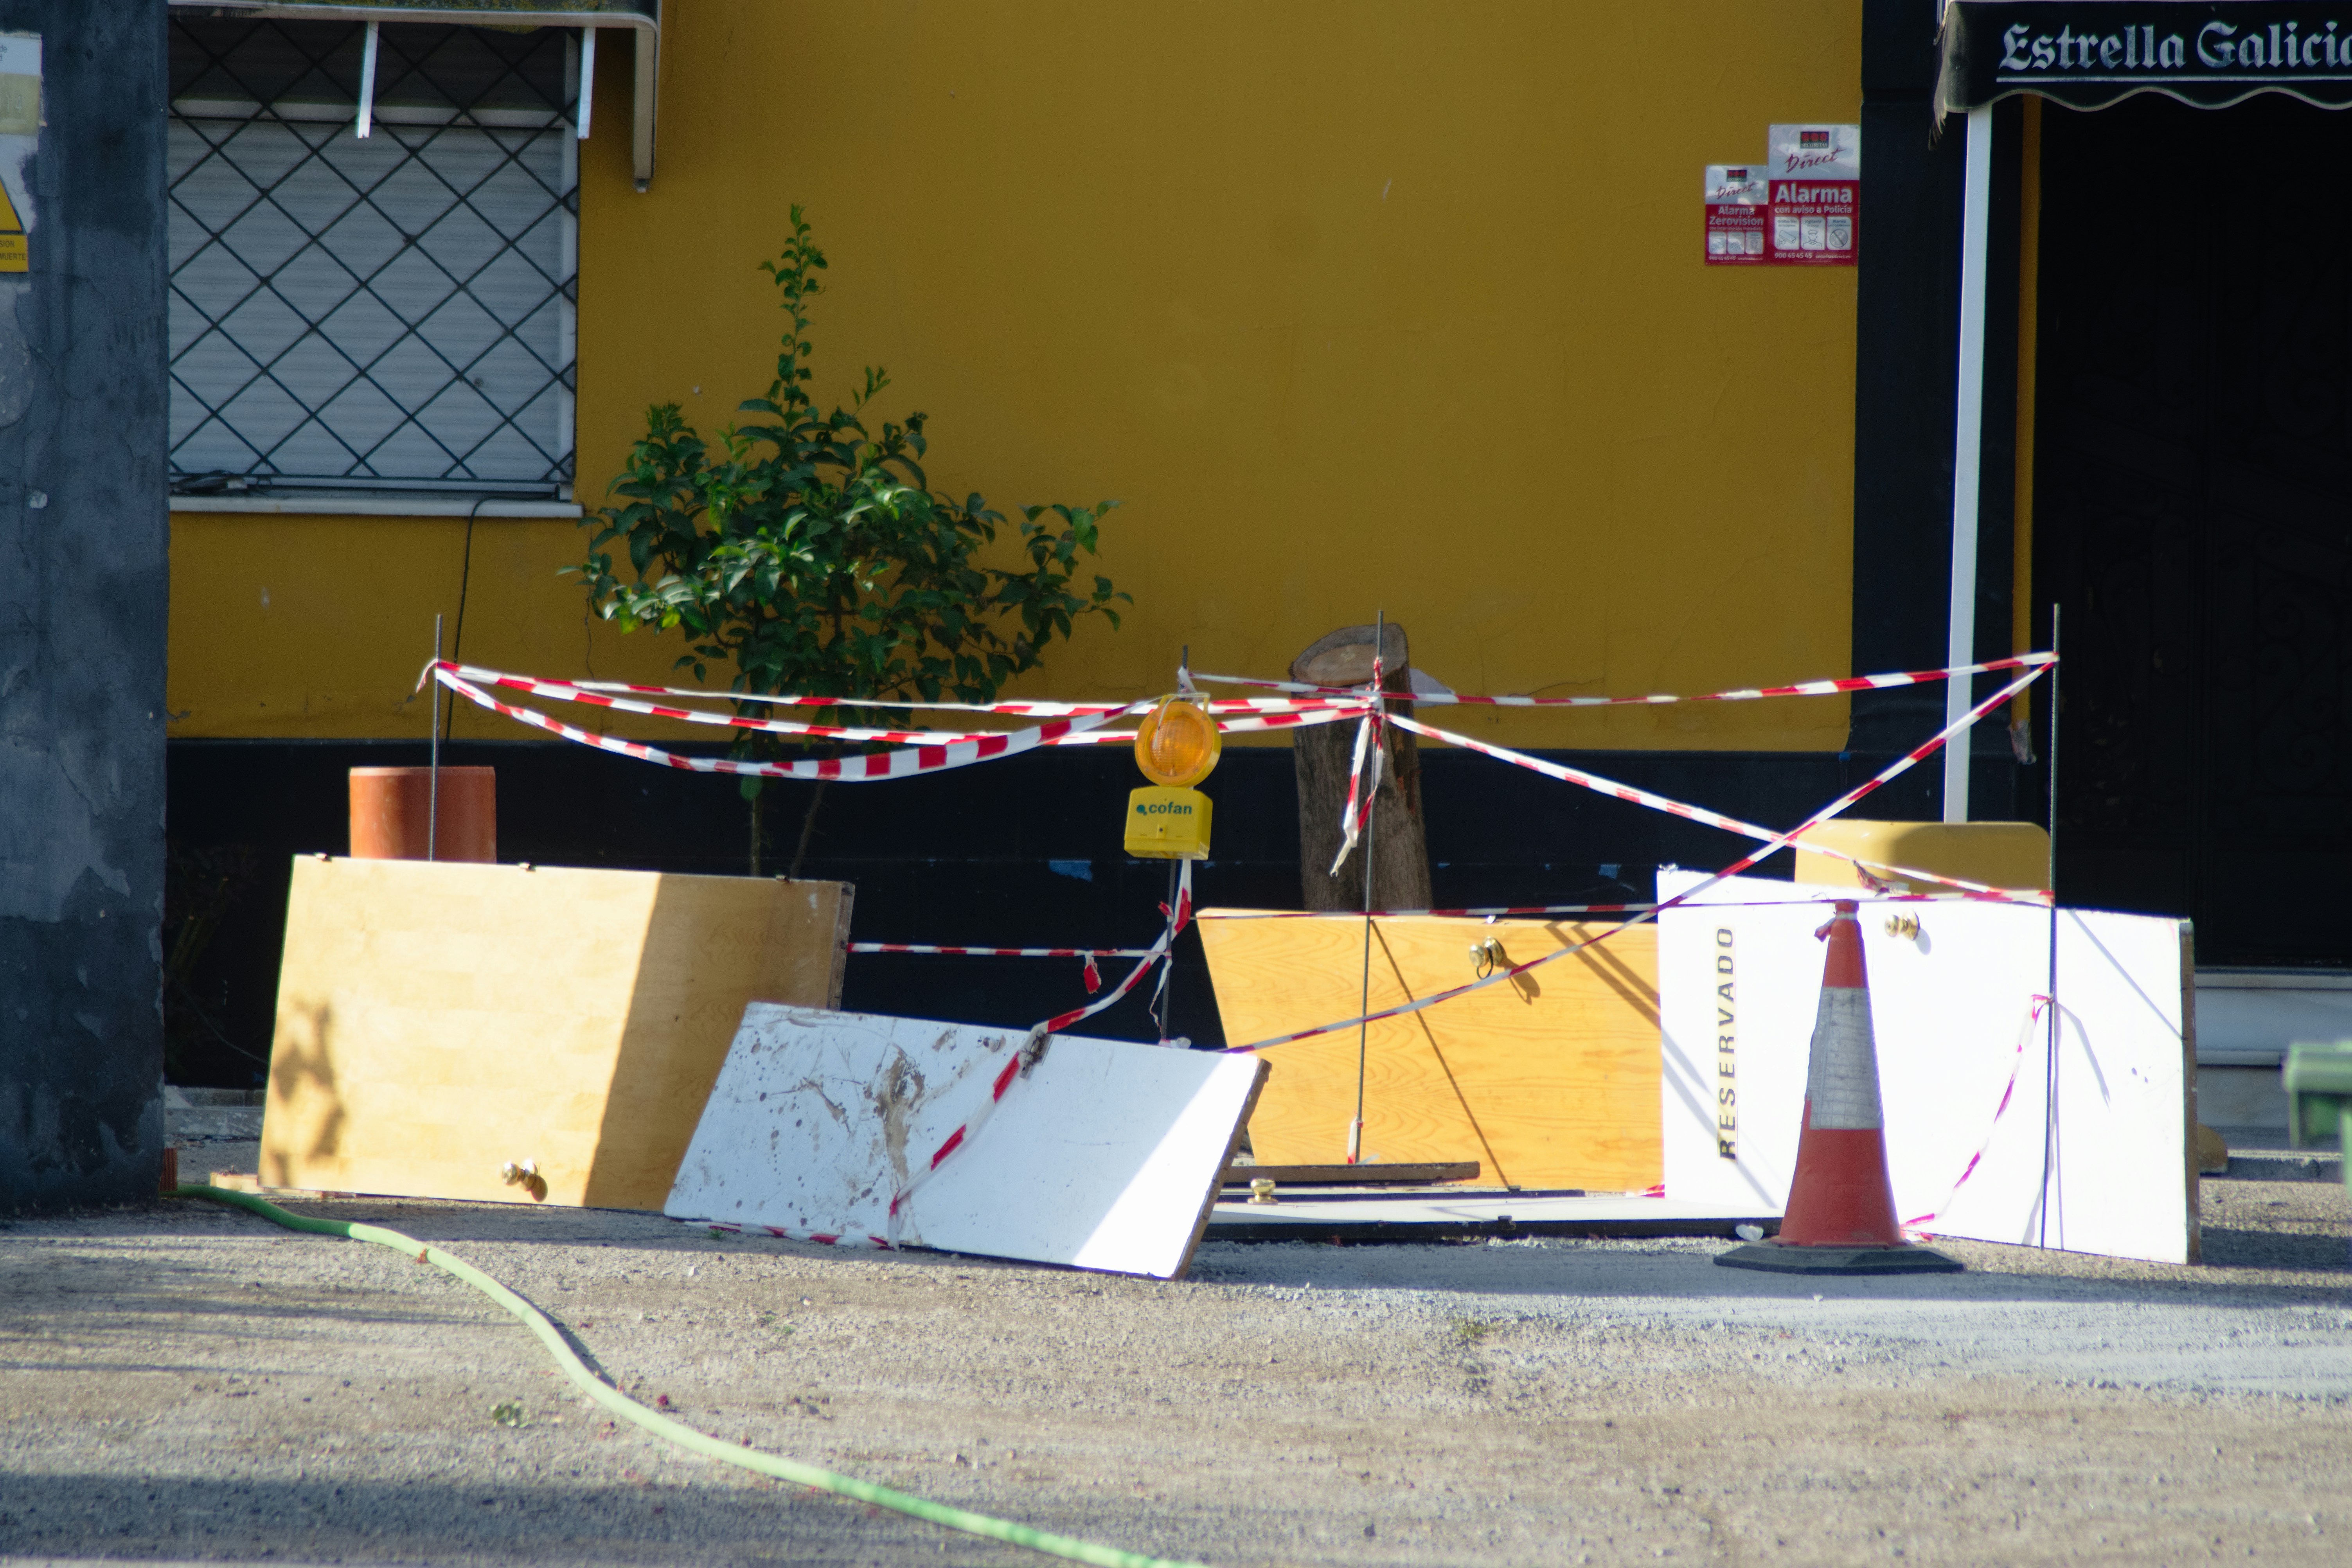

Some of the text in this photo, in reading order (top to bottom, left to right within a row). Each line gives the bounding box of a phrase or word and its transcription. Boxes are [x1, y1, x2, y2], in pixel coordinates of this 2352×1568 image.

[1998, 22, 2187, 70] Estrella
[1784, 148, 1847, 173] Direct
[1715, 182, 1759, 200] Direct
[1775, 183, 1852, 203] Alarma
[1718, 206, 1754, 215] Alarma
[1792, 205, 1814, 213] aviso
[1824, 205, 1852, 213] Policía
[1709, 216, 1764, 225] Zerovision
[1149, 802, 1192, 815] cofan
[1717, 928, 1736, 1160] RESERVADO
